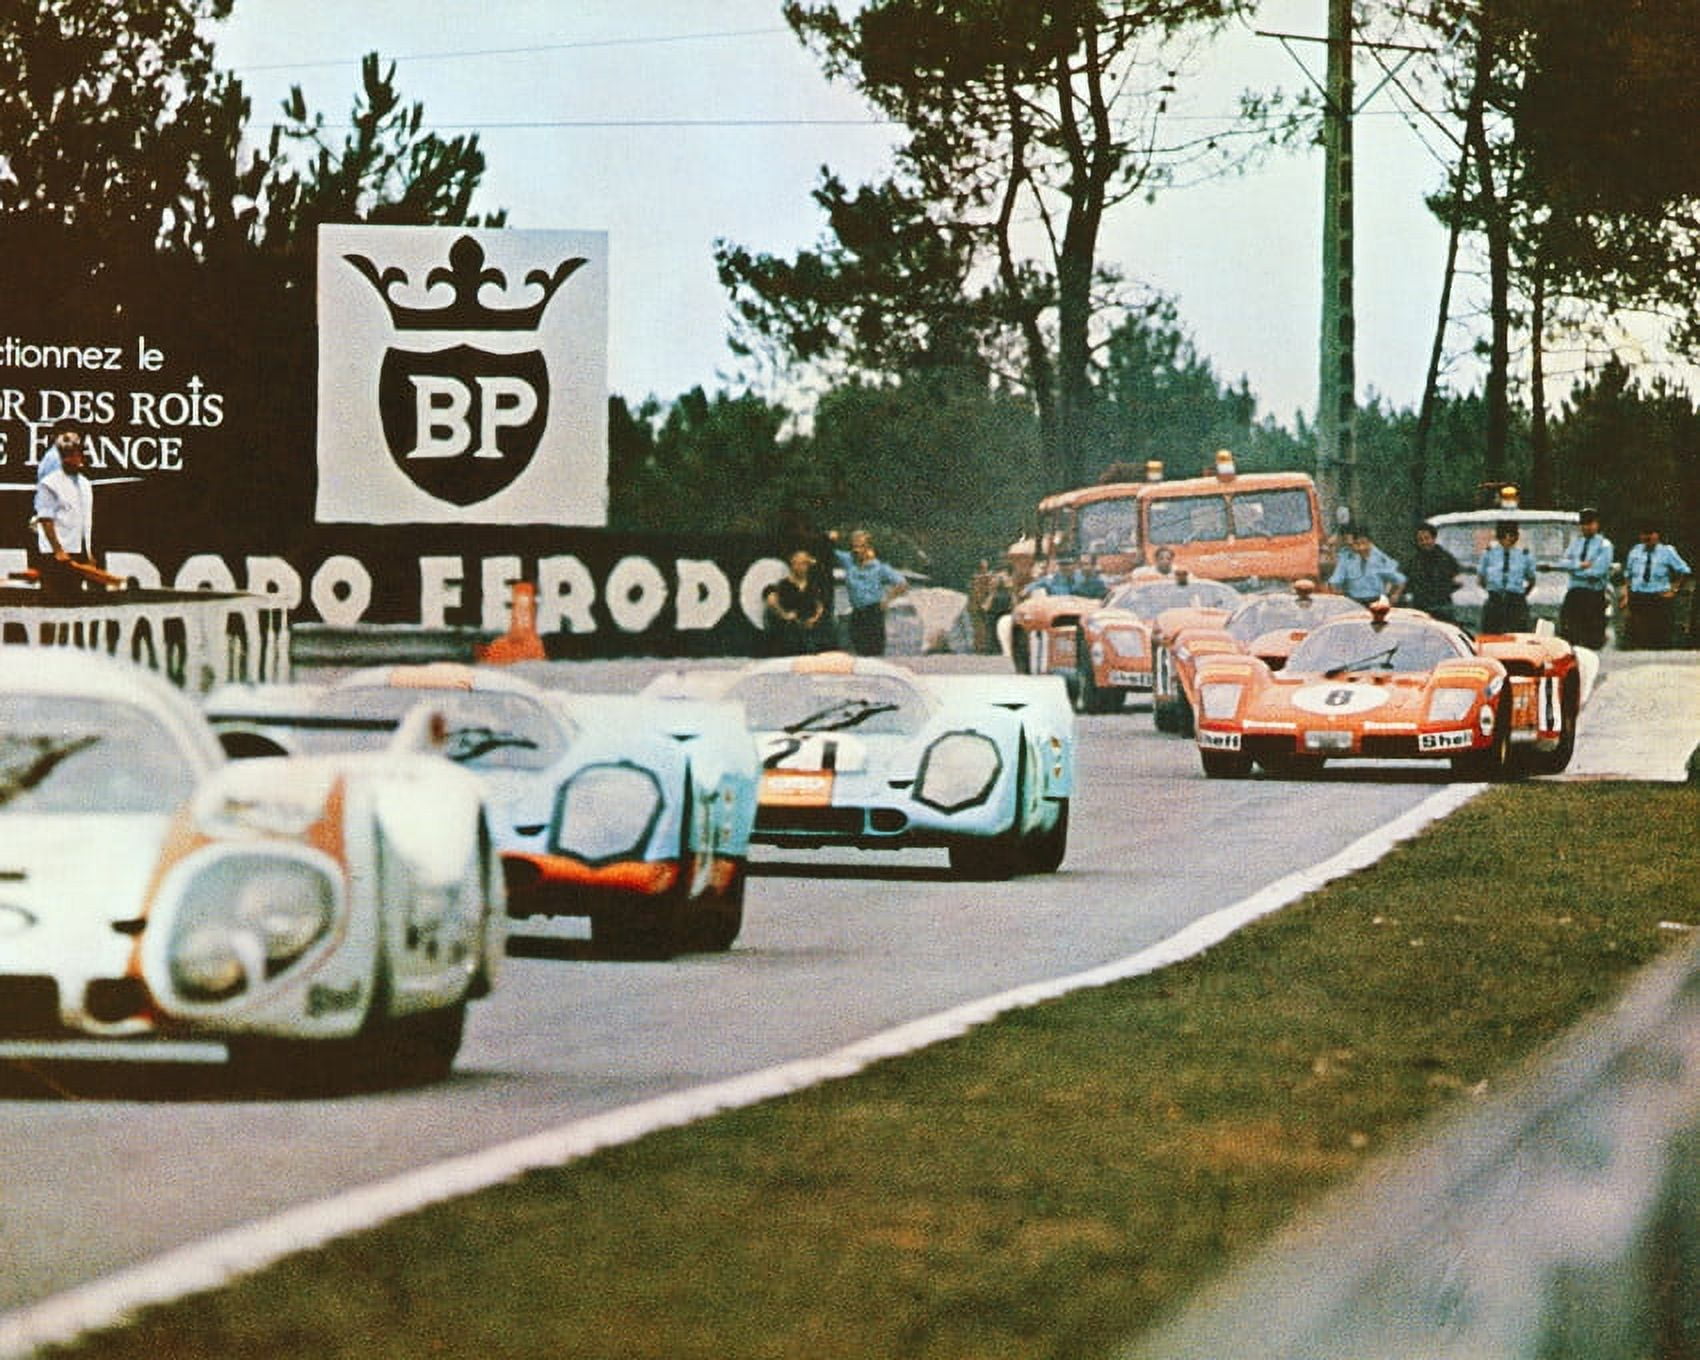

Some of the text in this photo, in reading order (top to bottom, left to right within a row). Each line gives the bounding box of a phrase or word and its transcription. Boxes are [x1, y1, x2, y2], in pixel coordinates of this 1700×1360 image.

[139, 336, 164, 371] le
[0, 375, 224, 429] R DES ROIS
[405, 375, 538, 458] BP
[24, 421, 183, 470] FANCE
[0, 549, 371, 624] ODO
[763, 738, 838, 770] 21
[1201, 733, 1239, 748] hell
